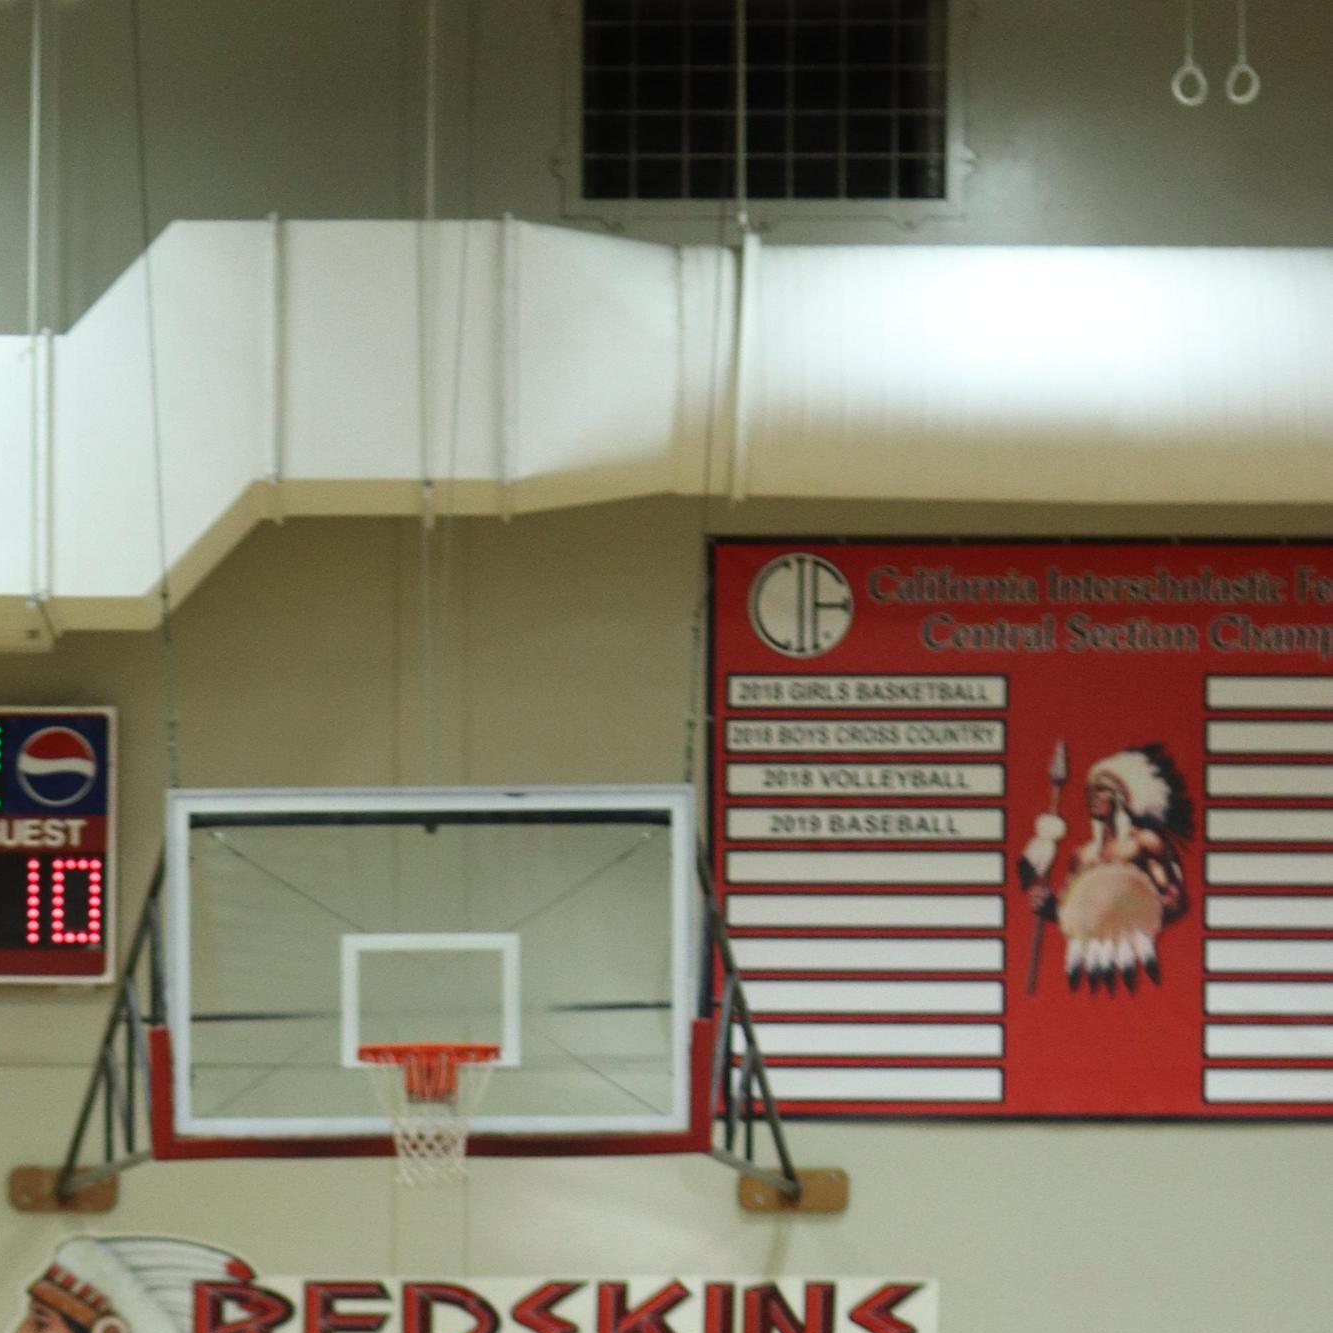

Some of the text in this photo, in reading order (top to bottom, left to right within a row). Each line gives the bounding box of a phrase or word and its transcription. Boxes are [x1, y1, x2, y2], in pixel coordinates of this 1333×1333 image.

[868, 565, 1040, 604] California
[1047, 565, 1286, 604] Interscholastic
[920, 612, 1057, 651] Central
[1066, 612, 1199, 651] Section
[788, 682, 851, 700] GIRLS
[855, 682, 988, 700] BASKETBALL
[777, 726, 830, 745] BOYS
[834, 726, 900, 745] CROSS
[905, 725, 996, 745] COUNTRY
[818, 769, 969, 788] VOLLEYBALL
[828, 815, 961, 834] BASEBALL
[27, 857, 102, 944] 10
